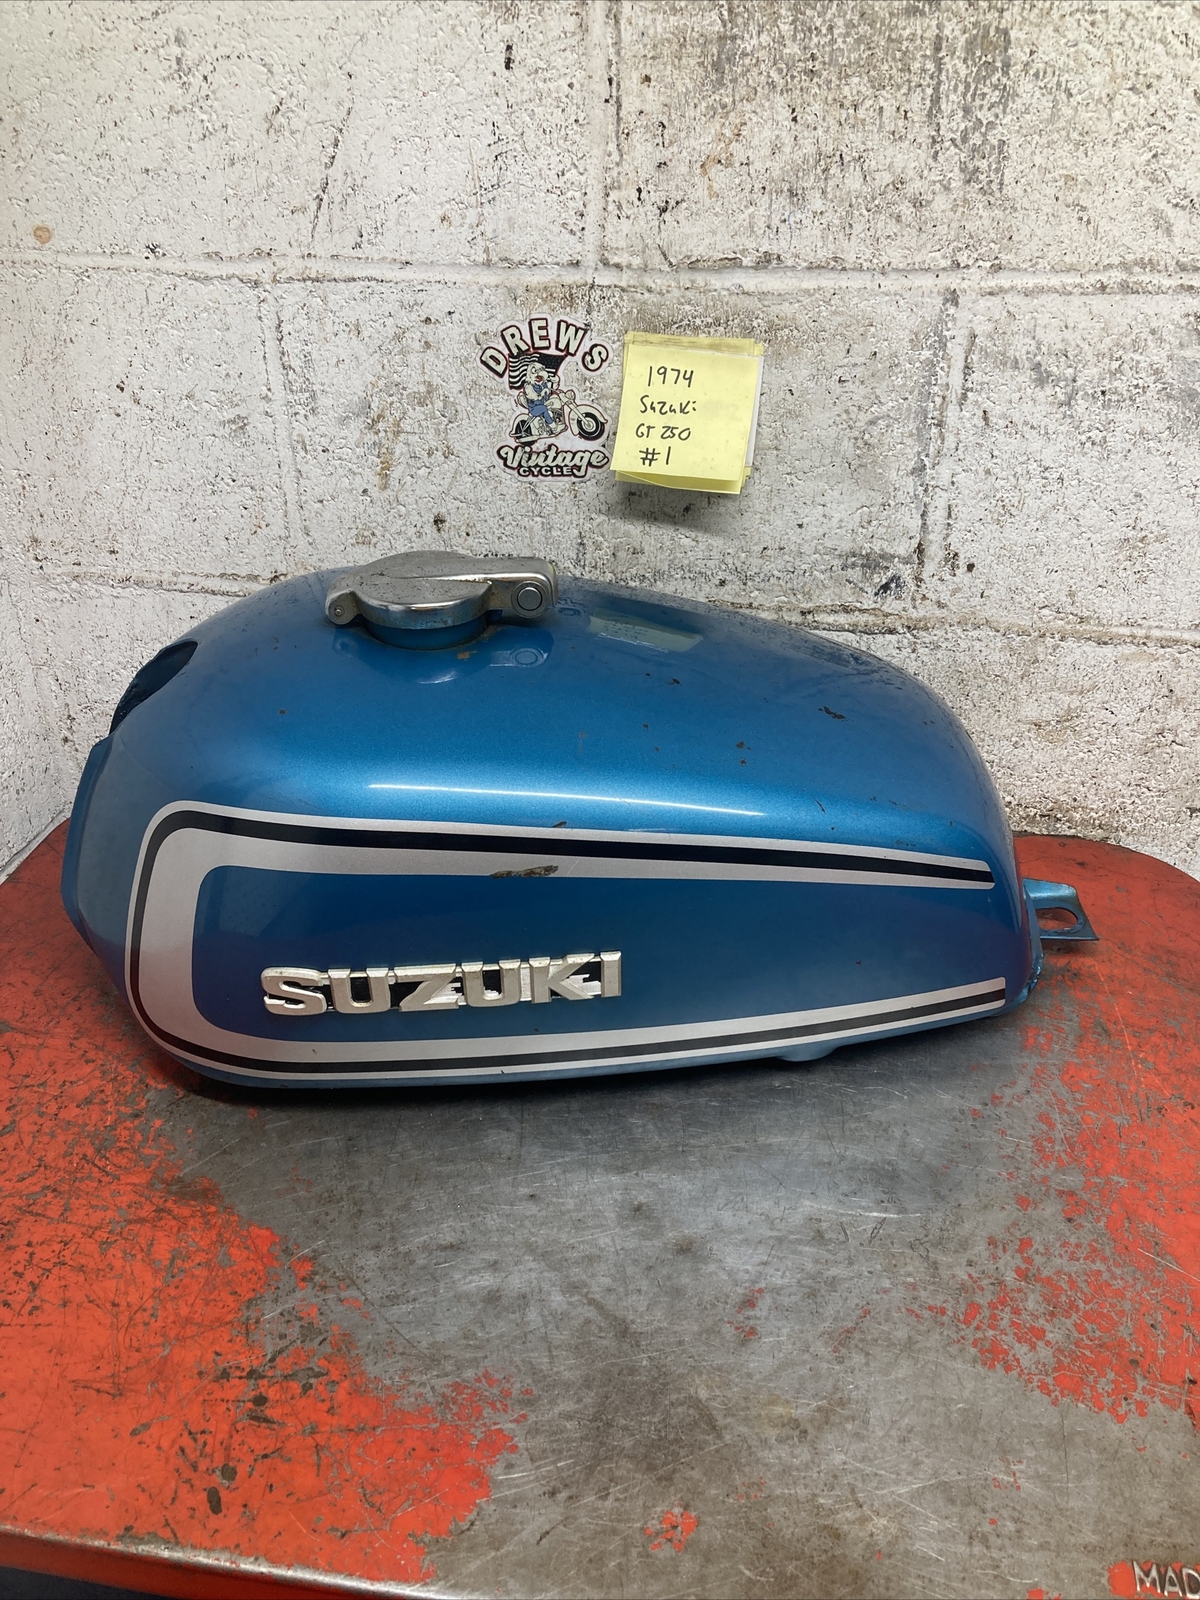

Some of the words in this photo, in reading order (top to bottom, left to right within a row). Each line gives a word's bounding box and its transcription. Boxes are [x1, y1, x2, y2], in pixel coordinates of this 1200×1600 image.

[480, 318, 608, 378] DREWS
[647, 365, 694, 388] 1974
[635, 423, 655, 438] GT
[660, 425, 691, 441] 250
[498, 443, 609, 477] Vintage
[261, 950, 622, 1016] SUZUKI
